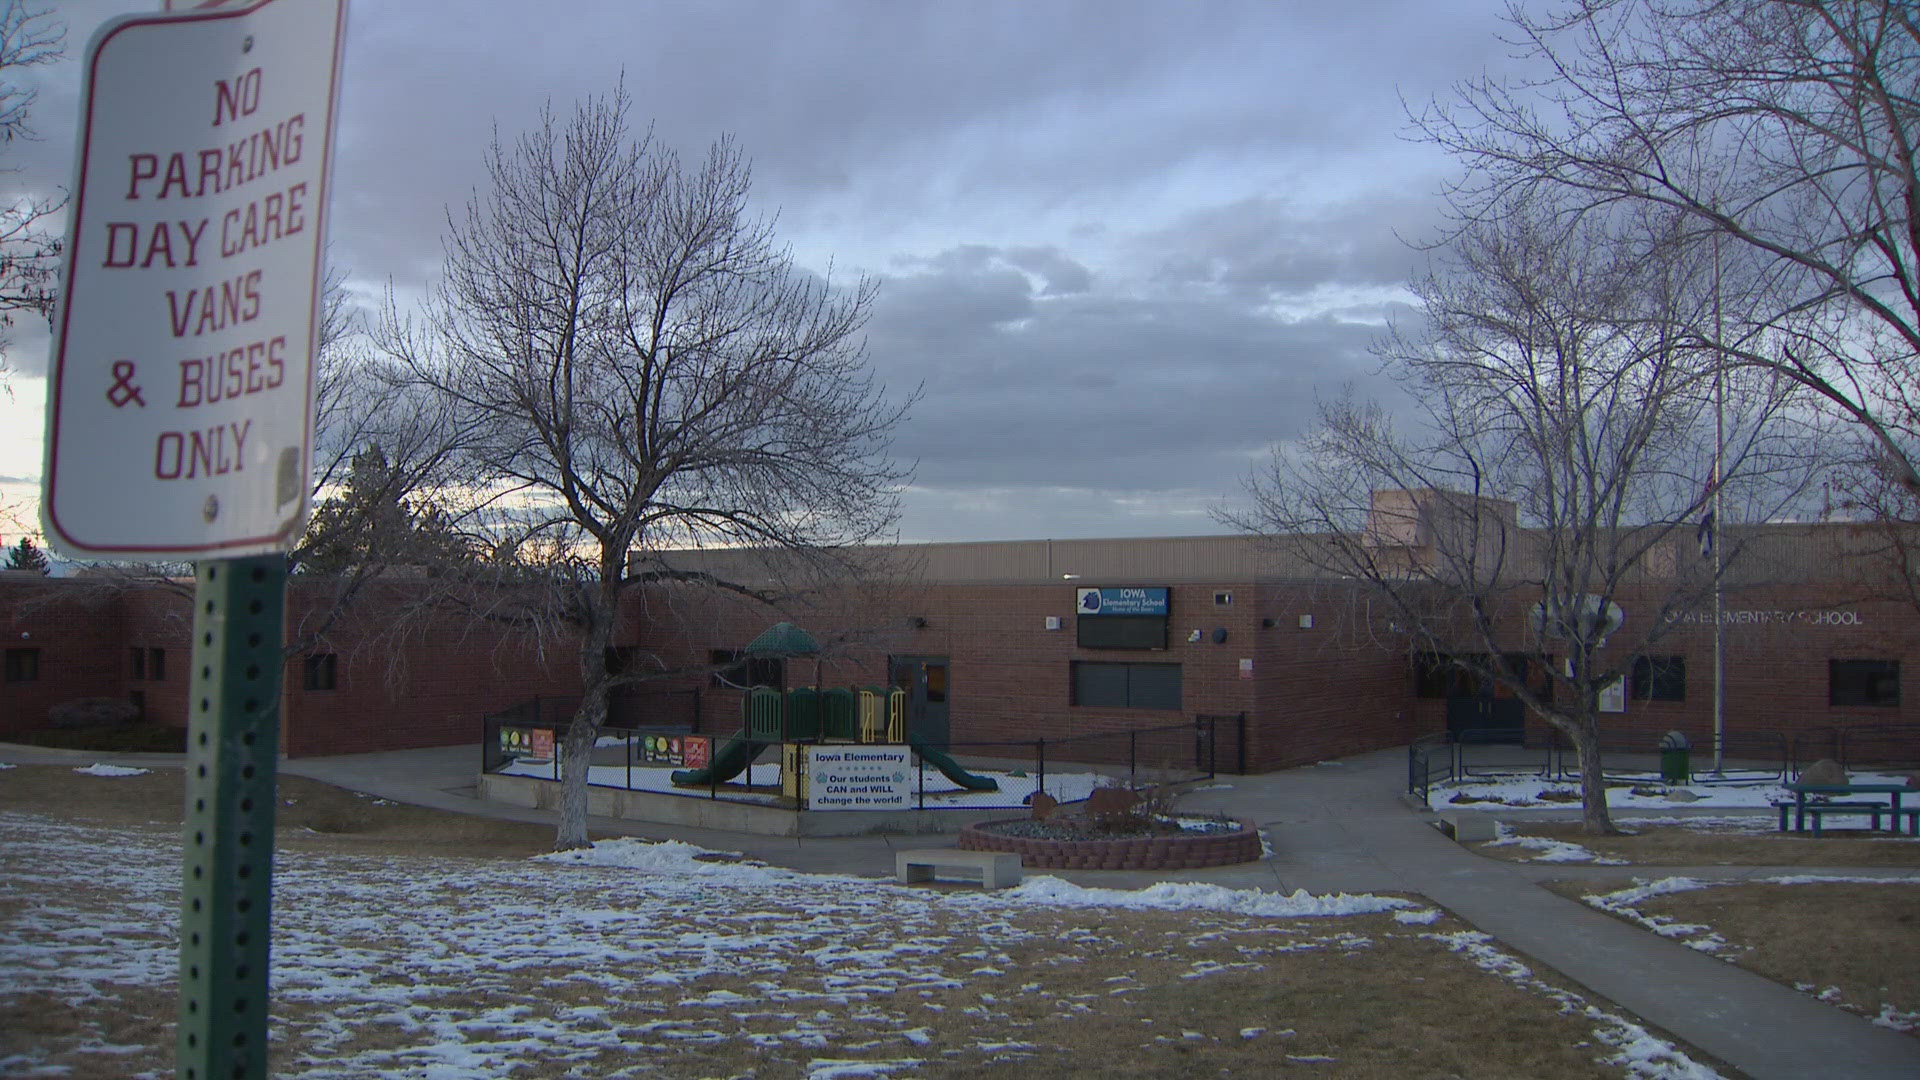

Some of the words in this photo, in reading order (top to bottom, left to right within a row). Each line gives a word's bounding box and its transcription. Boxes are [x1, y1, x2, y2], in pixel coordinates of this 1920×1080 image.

[213, 67, 262, 127] NO
[126, 113, 305, 201] PARKING
[103, 217, 208, 269] DAY
[220, 182, 308, 259] CARE
[166, 270, 262, 338] VANS
[107, 360, 146, 409] &
[177, 336, 287, 408] BUSES
[155, 420, 253, 481] ONLY
[1103, 598, 1140, 608] Elementary
[1142, 598, 1165, 607] School
[1120, 588, 1146, 598] IOWA
[815, 753, 841, 762] Iowa
[844, 753, 905, 763] Elementary
[826, 785, 847, 793] CAN
[850, 785, 867, 793] and
[870, 785, 894, 793] WILL
[829, 775, 847, 783] Our
[849, 775, 890, 783] students
[818, 796, 853, 806] change
[855, 796, 871, 804] the
[873, 796, 903, 804] world!
